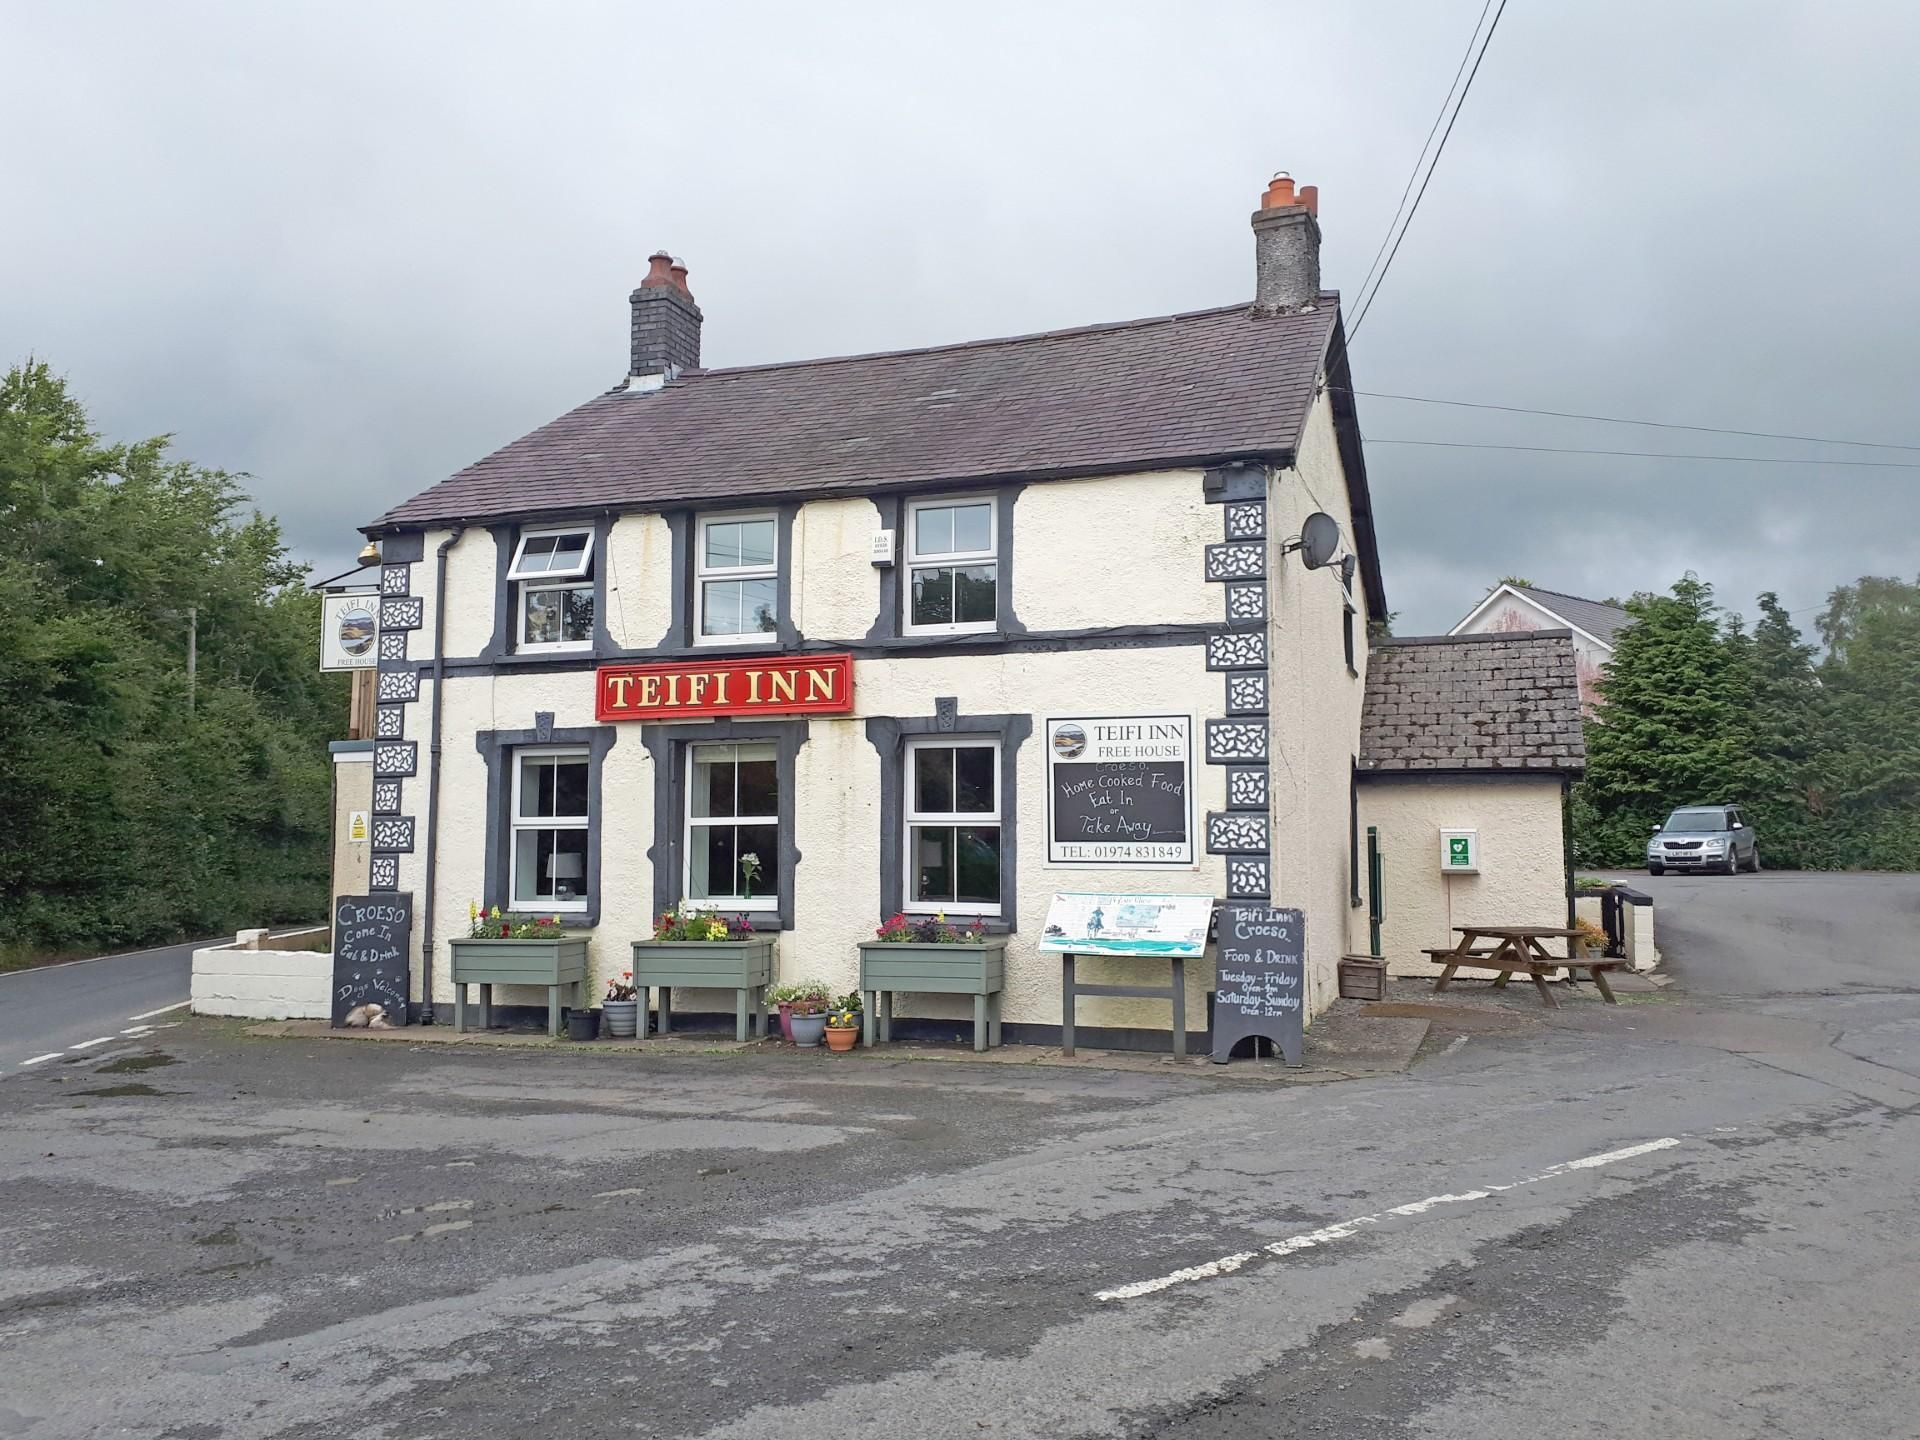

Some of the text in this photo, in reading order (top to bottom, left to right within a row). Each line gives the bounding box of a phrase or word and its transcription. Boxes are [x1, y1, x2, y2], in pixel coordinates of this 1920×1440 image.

[336, 598, 360, 620] TEIFI
[337, 657, 377, 666] FREE HOUSE
[608, 668, 837, 708] TEIFI INN
[1094, 724, 1184, 741] TEIFI INN
[1098, 745, 1181, 757] FREE HOUSE
[1098, 772, 1144, 788] Cooked
[1151, 773, 1184, 797] Food
[1089, 790, 1134, 808] Eat In
[1080, 815, 1152, 840] Take Away
[1060, 845, 1182, 858] TEL: 01974 831849
[1230, 907, 1262, 922] Teifi
[377, 924, 392, 942] In
[340, 944, 358, 960] Eat
[337, 983, 369, 1001] Dogs
